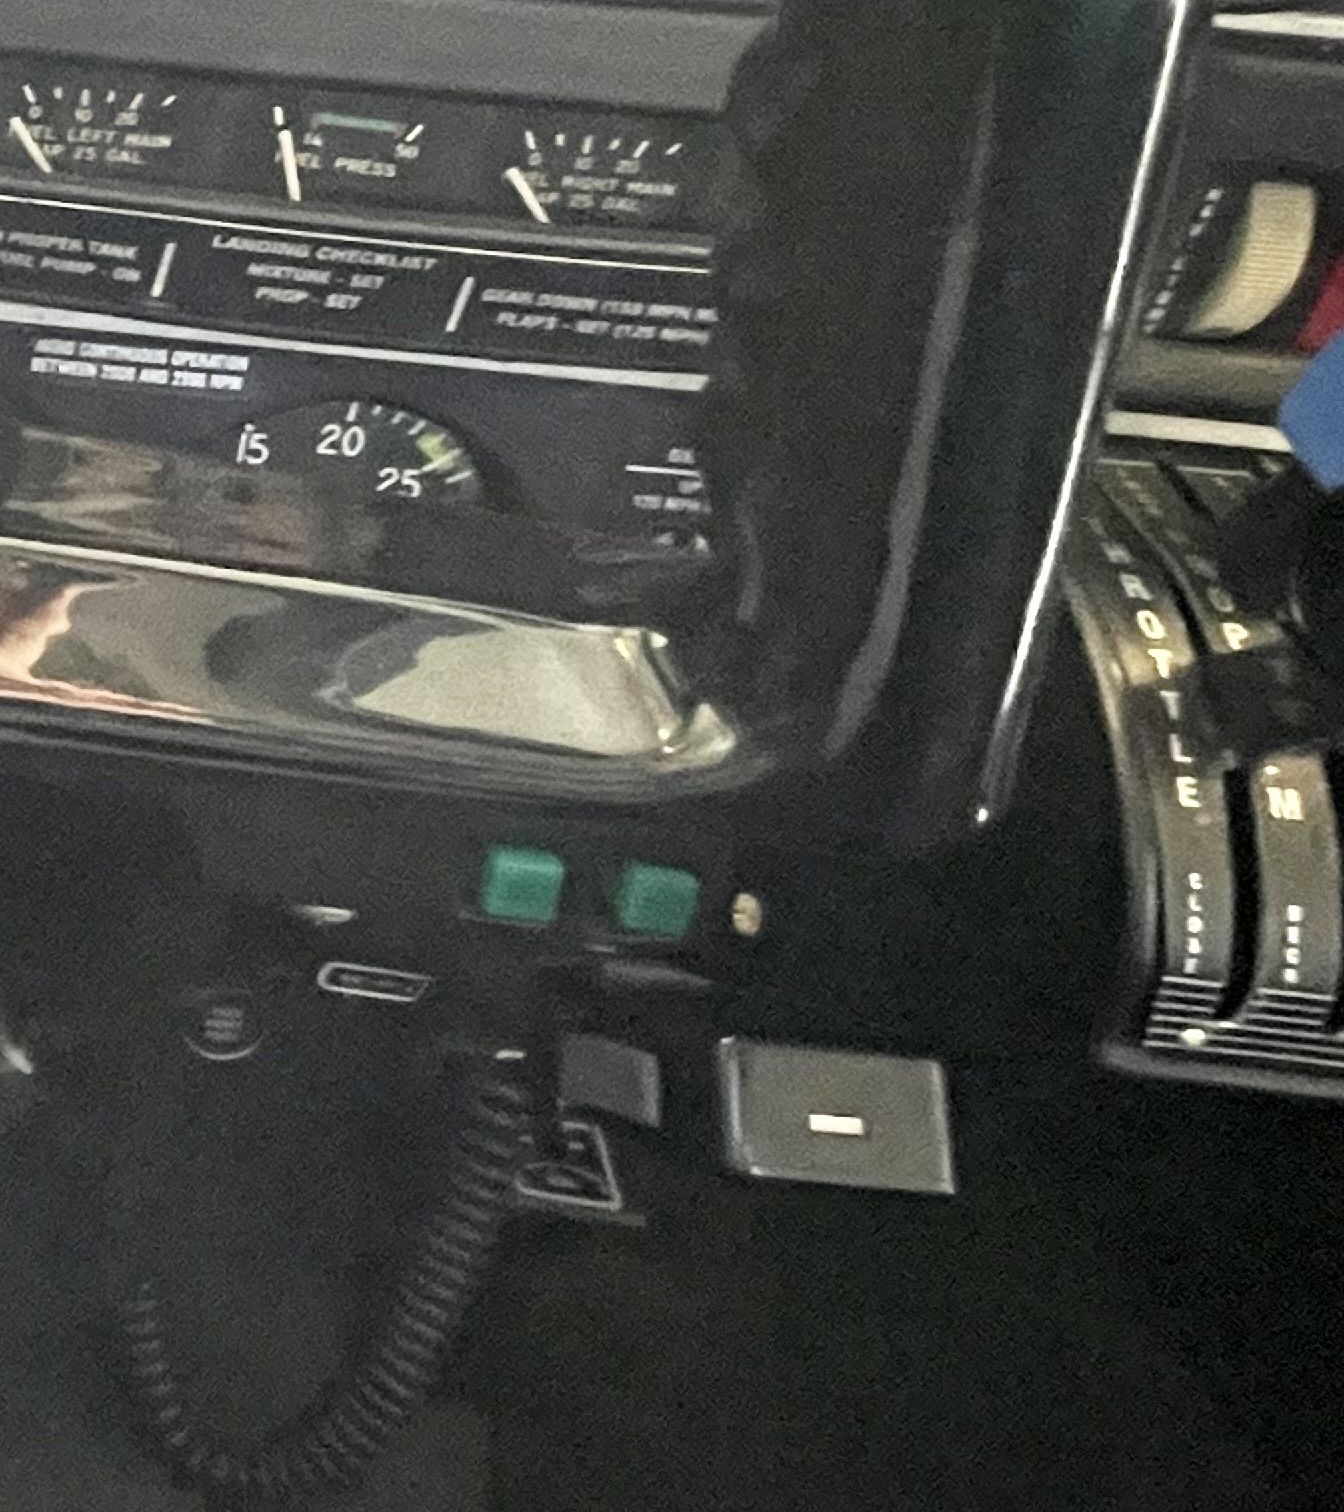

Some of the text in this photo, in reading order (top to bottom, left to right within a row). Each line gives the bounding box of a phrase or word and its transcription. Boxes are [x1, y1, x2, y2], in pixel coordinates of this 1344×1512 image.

[236, 423, 270, 465] 15
[315, 424, 366, 458] 20
[375, 465, 423, 499] 25
